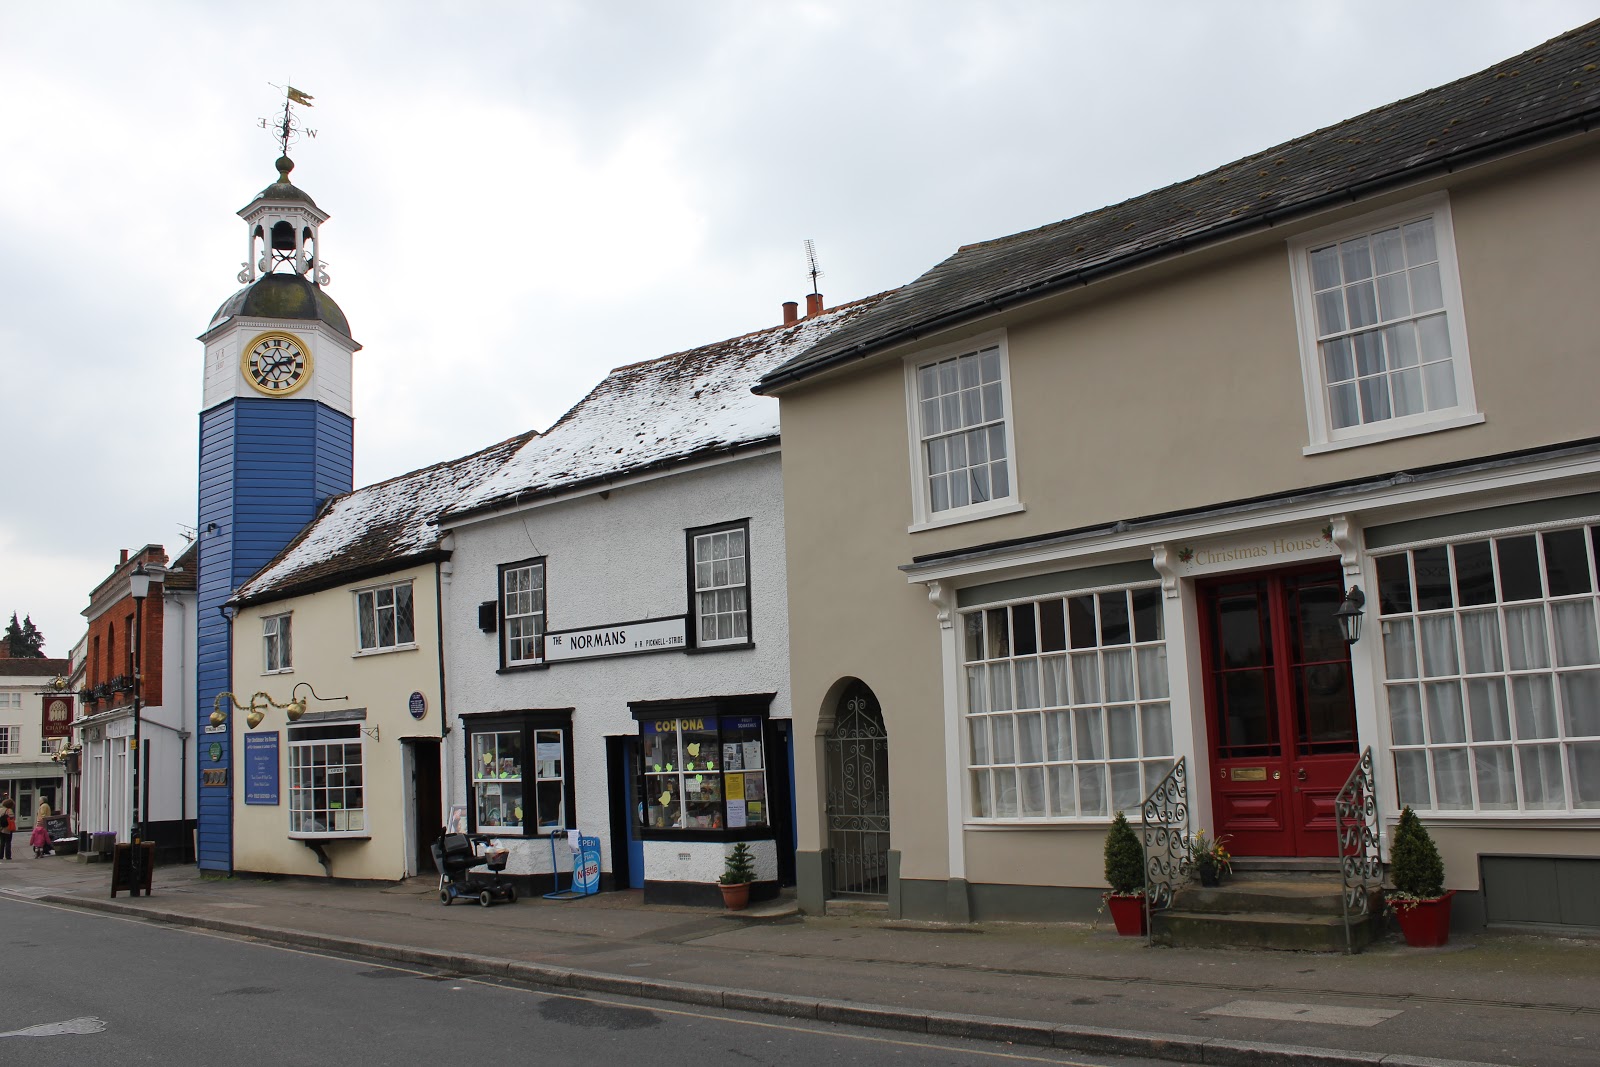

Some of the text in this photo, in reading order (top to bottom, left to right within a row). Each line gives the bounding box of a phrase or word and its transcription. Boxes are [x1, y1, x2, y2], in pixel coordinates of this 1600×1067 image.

[1195, 537, 1321, 566] Christmas House
[553, 636, 562, 646] THE
[570, 630, 626, 650] NORMANS
[655, 719, 704, 733] CORONA
[1220, 768, 1227, 779] 5
